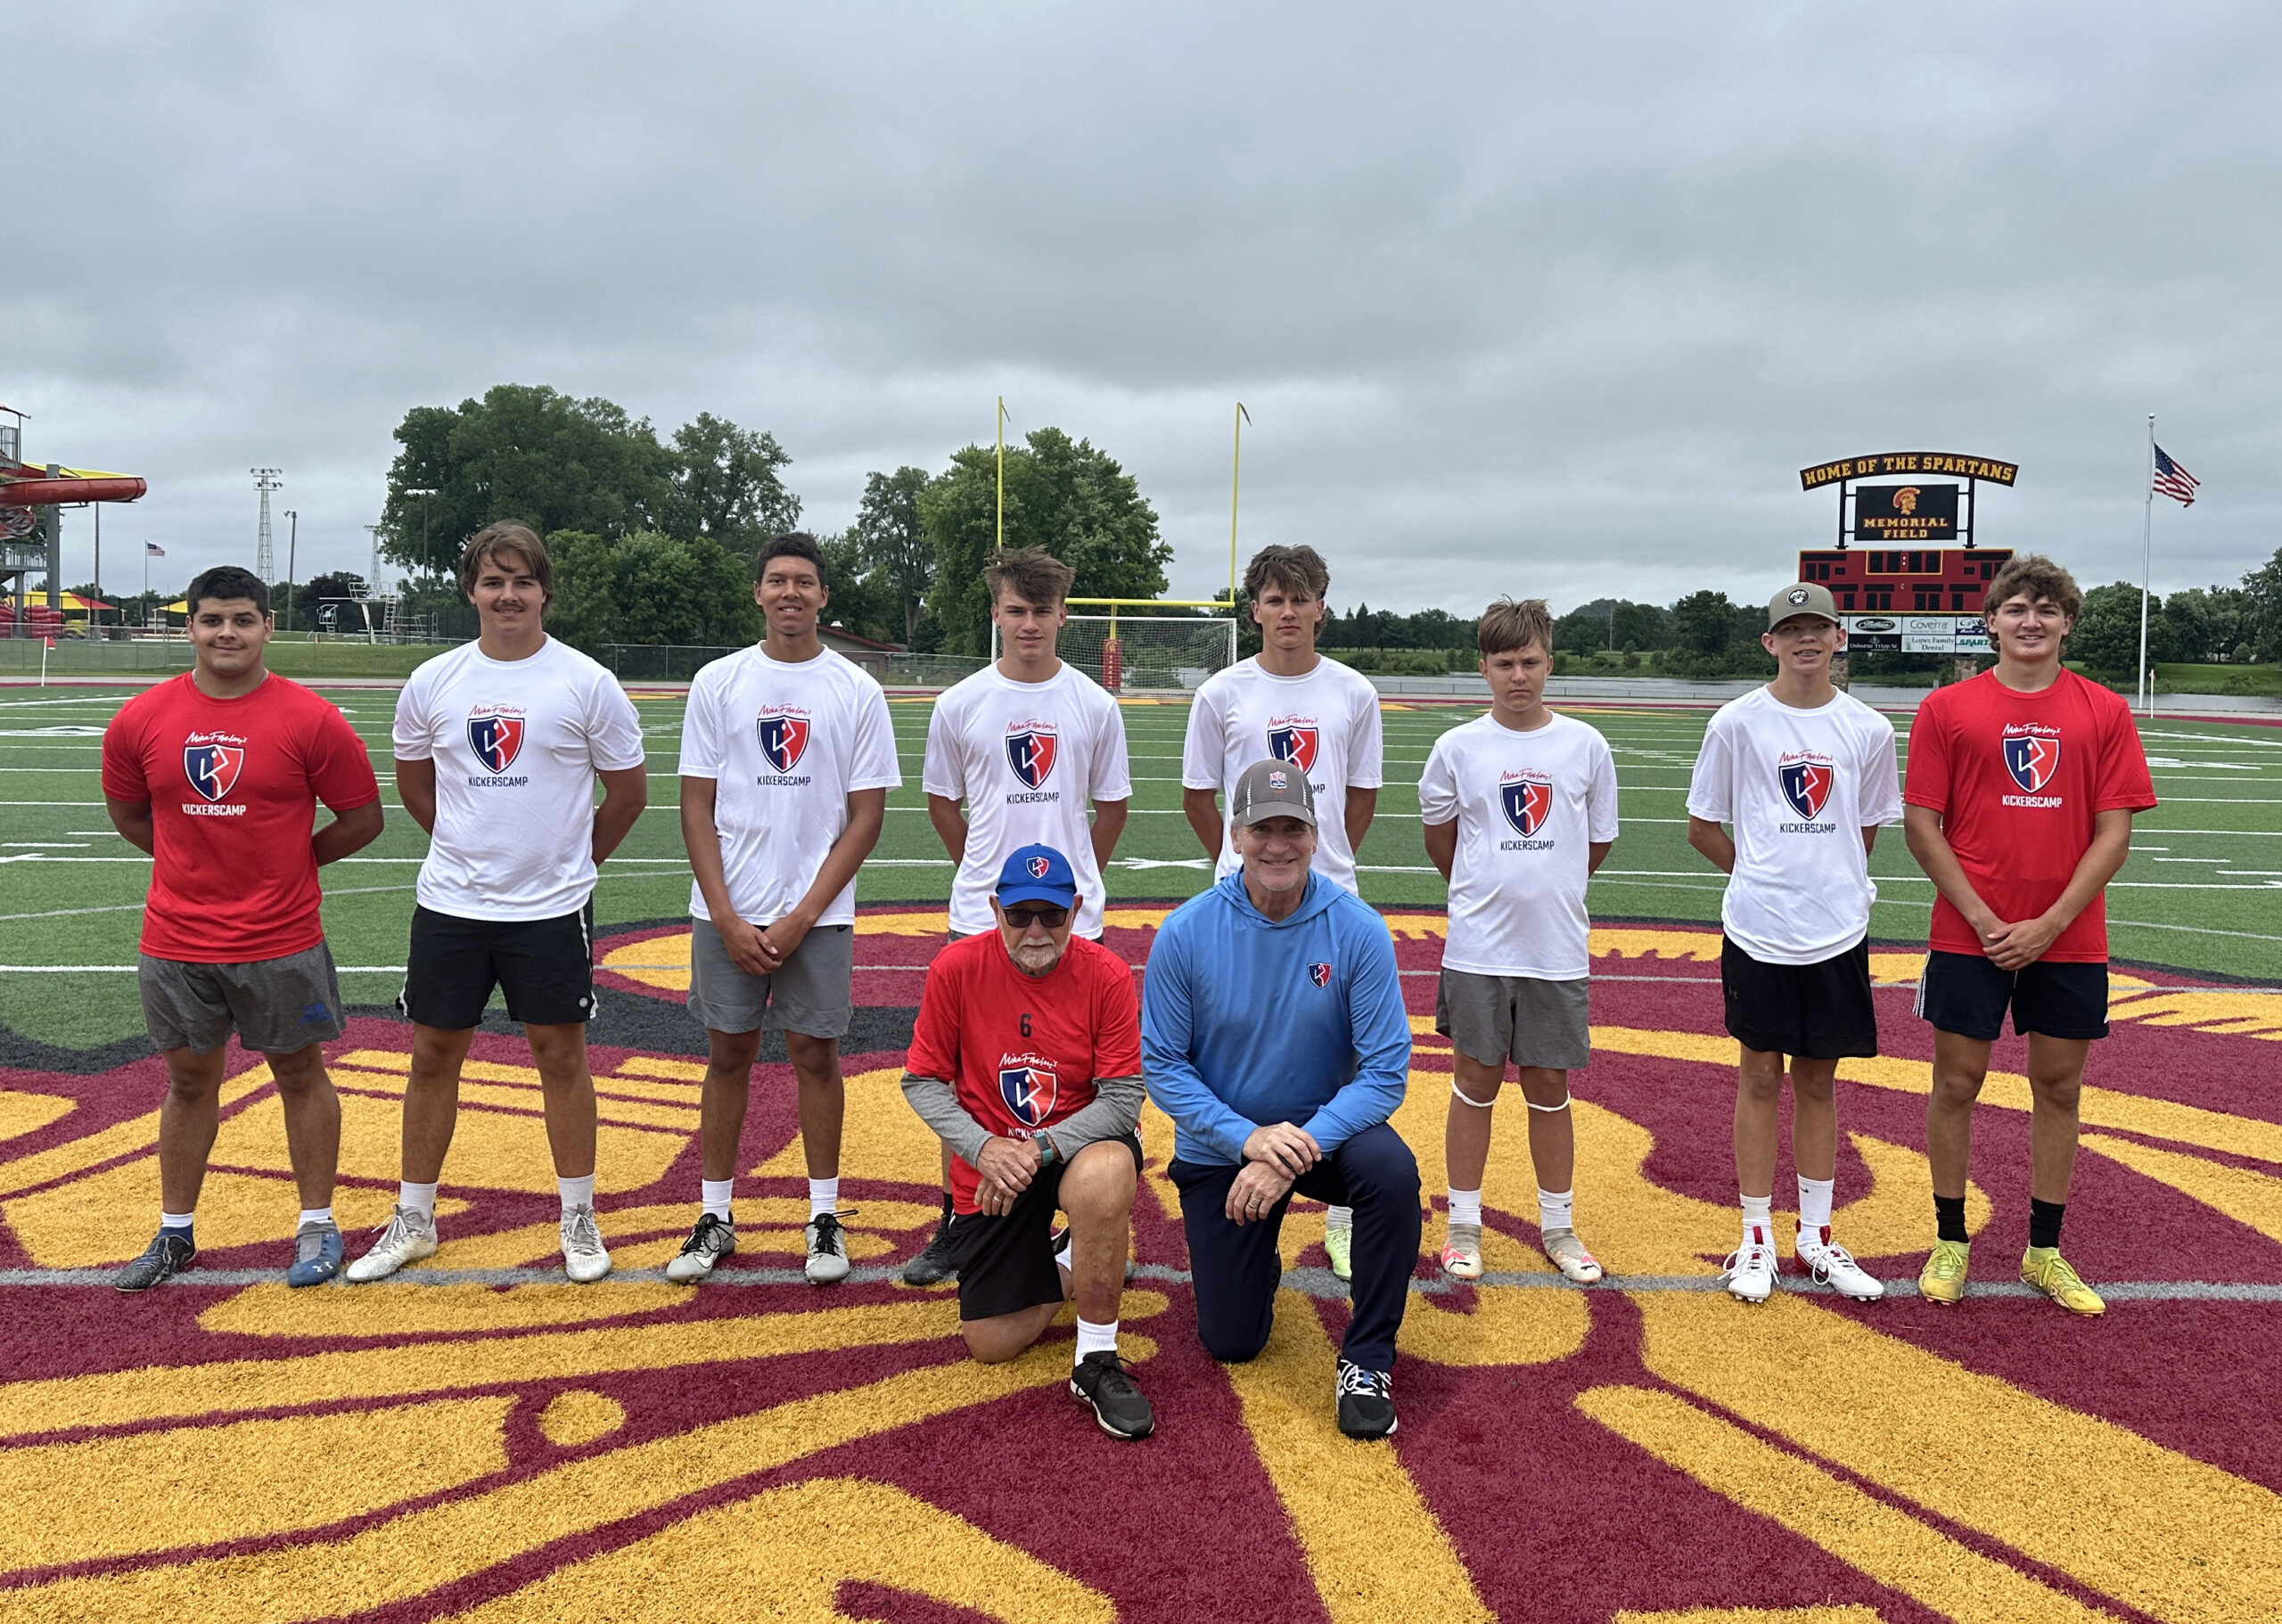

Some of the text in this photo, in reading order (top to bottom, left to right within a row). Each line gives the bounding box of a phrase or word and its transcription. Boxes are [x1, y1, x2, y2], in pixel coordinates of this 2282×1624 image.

[1804, 455, 2014, 486] HOME OF THE SPARTANS
[1864, 518, 1948, 528] MEMORIAL
[1883, 529, 1928, 538] FIELD
[1910, 619, 1948, 629] Coverra
[1959, 639, 1990, 647] SPART
[468, 776, 528, 787] KICKERSCAMP
[1006, 792, 1059, 805] KICKERSCAMP
[2002, 795, 2063, 808] KICKERSCAMP
[182, 803, 246, 816] KICKERSCAMP
[1780, 823, 1836, 833] KICKERSCAMP
[1500, 841, 1555, 850] KICKERSCAMP
[1020, 1013, 1032, 1038] 6
